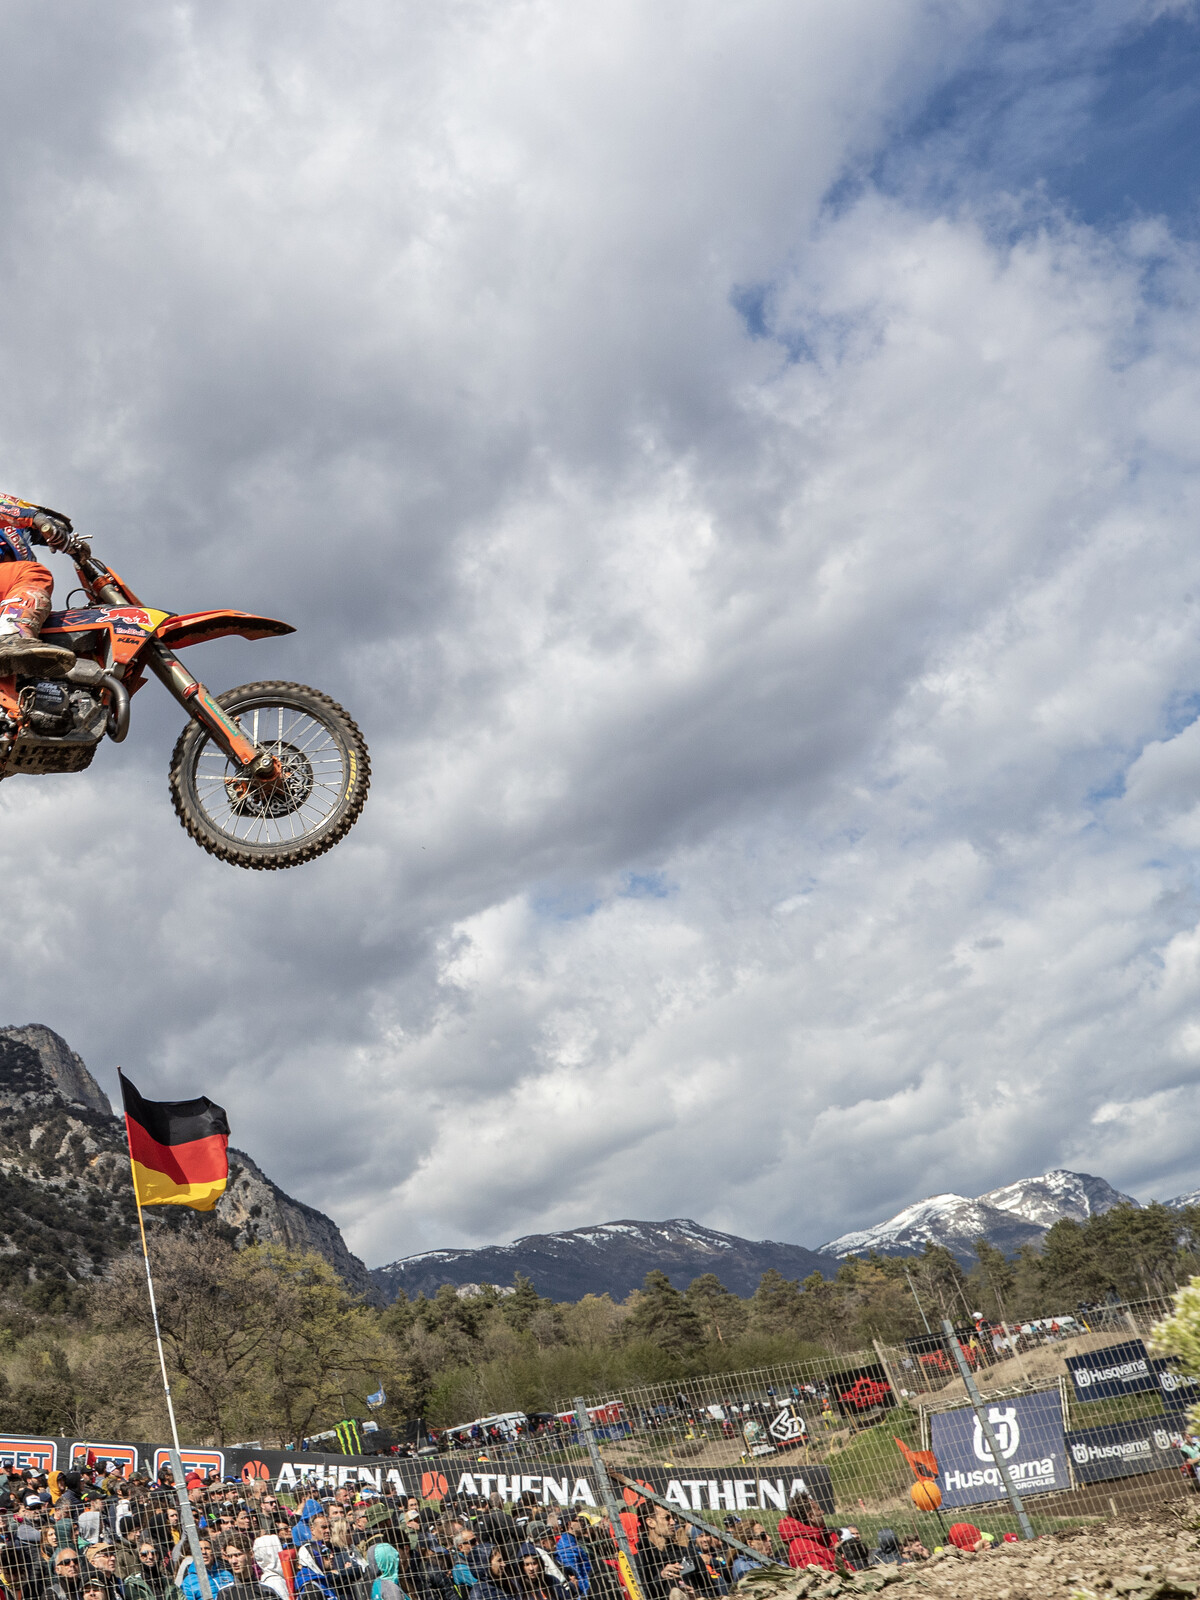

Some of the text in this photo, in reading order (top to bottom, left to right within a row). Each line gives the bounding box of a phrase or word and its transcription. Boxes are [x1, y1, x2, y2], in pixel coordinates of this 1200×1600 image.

[117, 637, 140, 646] KTM
[347, 749, 357, 801] PIRELLI
[1089, 1359, 1148, 1383] Husqvarna
[1088, 1439, 1151, 1460] Husqvarna
[274, 1462, 407, 1497] ATHENA
[456, 1473, 597, 1508] ATHENA
